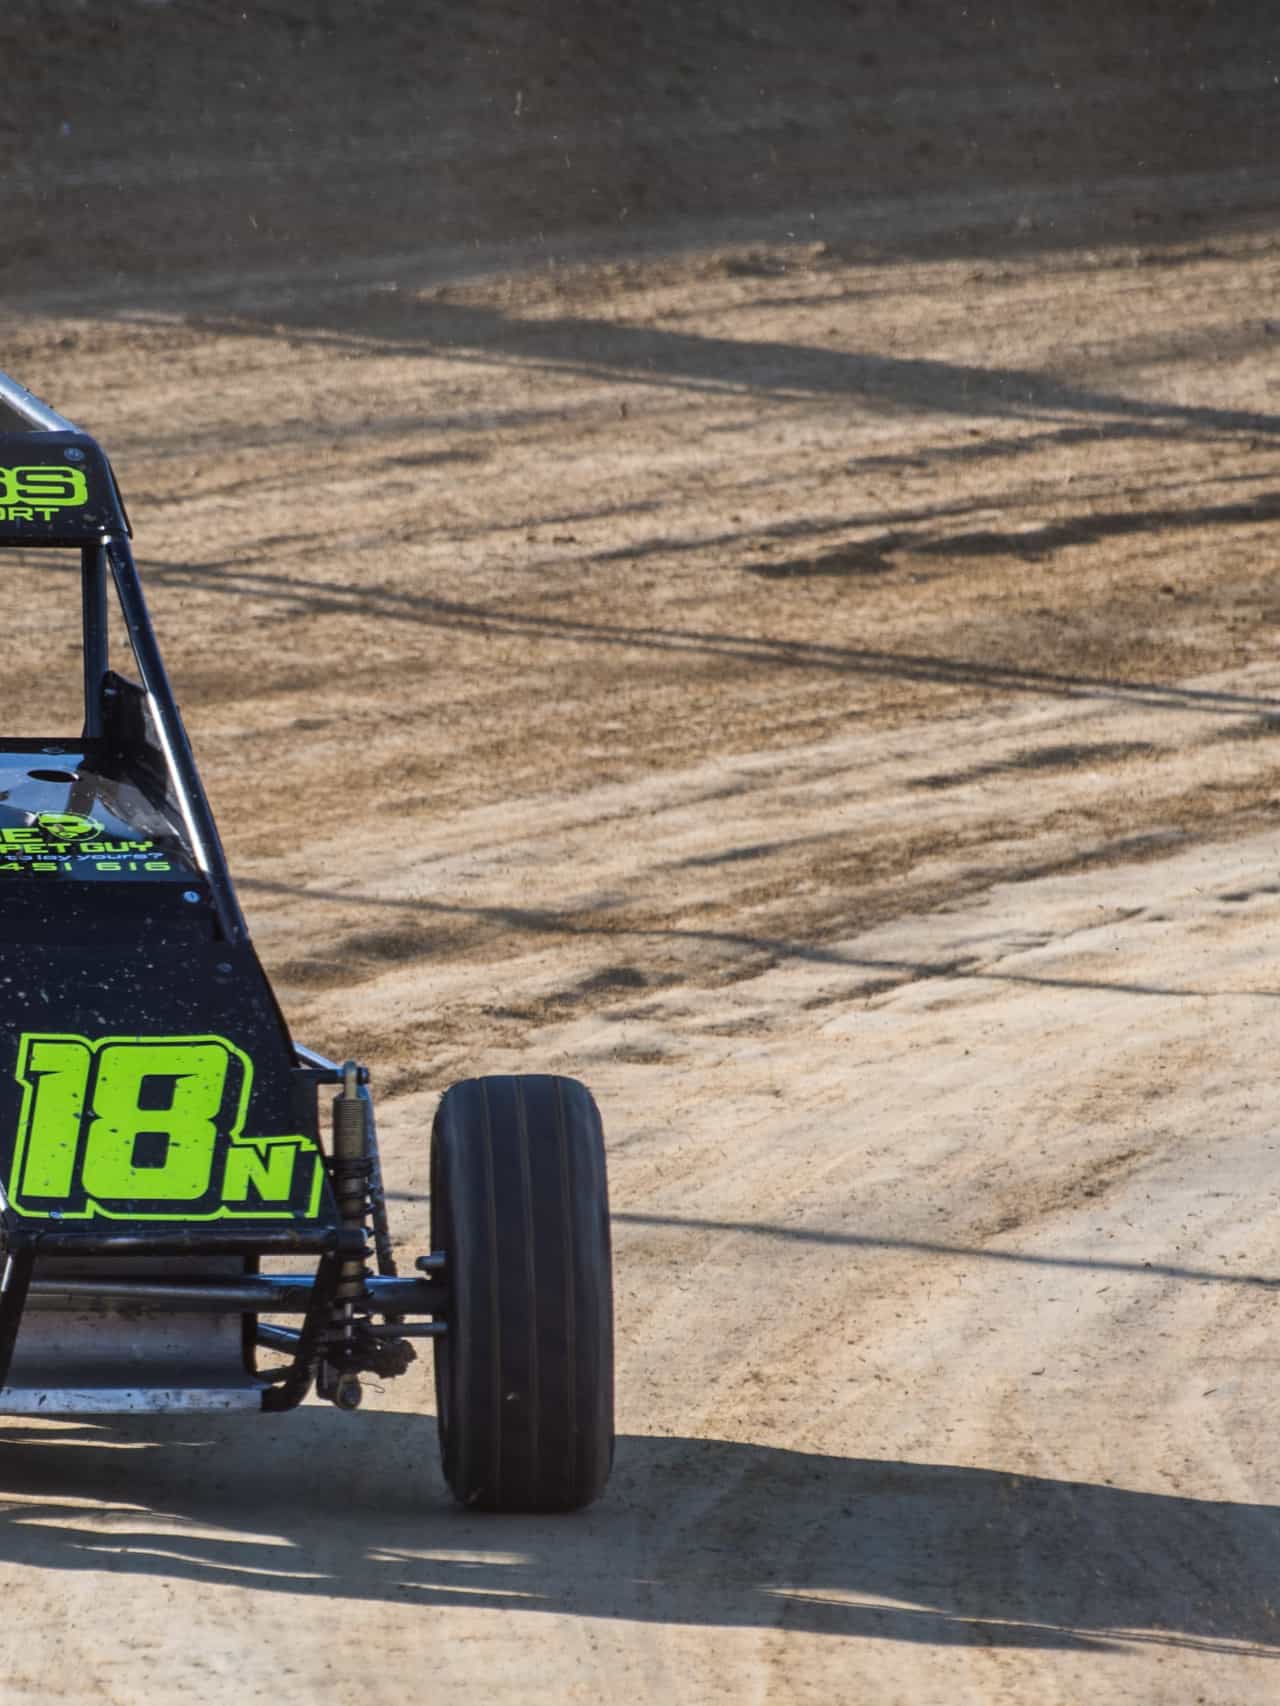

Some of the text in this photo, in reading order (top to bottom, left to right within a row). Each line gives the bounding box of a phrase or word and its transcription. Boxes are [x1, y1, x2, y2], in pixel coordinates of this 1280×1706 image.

[81, 841, 154, 853] GUY
[77, 852, 164, 862] yours?
[0, 861, 72, 871] 451
[97, 861, 171, 871] 616
